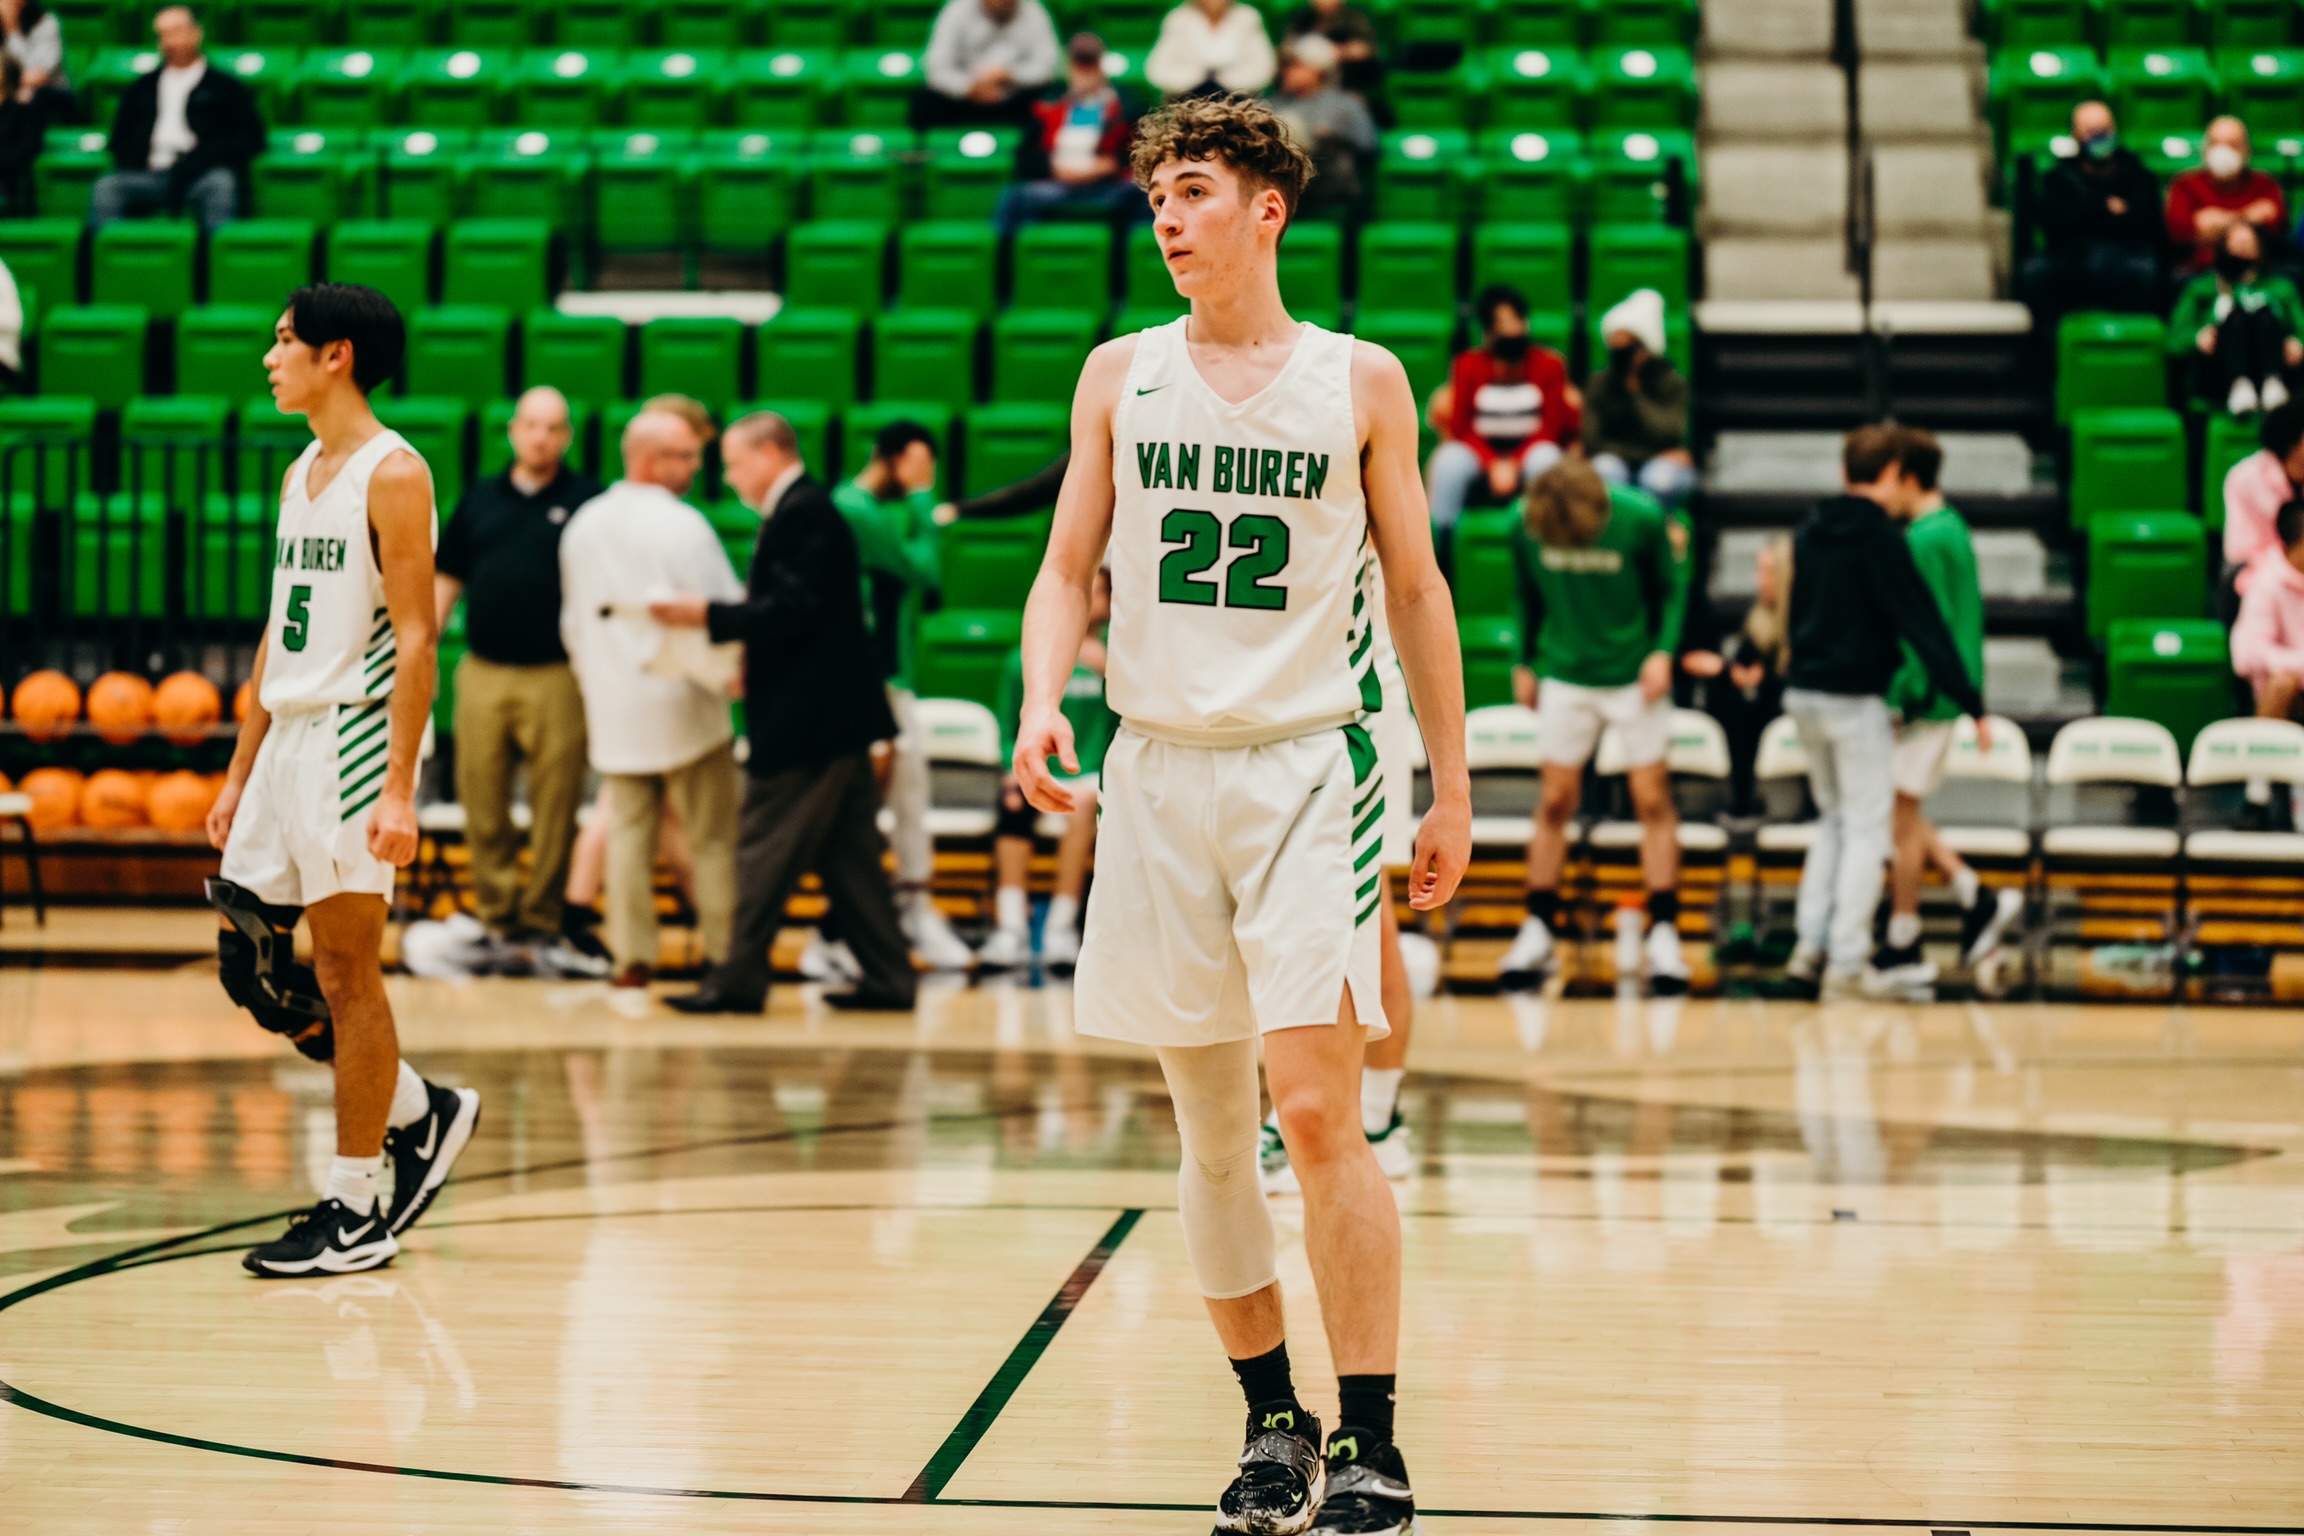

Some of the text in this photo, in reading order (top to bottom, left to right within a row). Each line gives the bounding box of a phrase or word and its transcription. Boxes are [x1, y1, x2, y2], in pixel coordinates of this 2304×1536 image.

[1136, 442, 1329, 500] VAN BUREN
[1159, 508, 1290, 610] 22
[282, 585, 312, 652] 5
